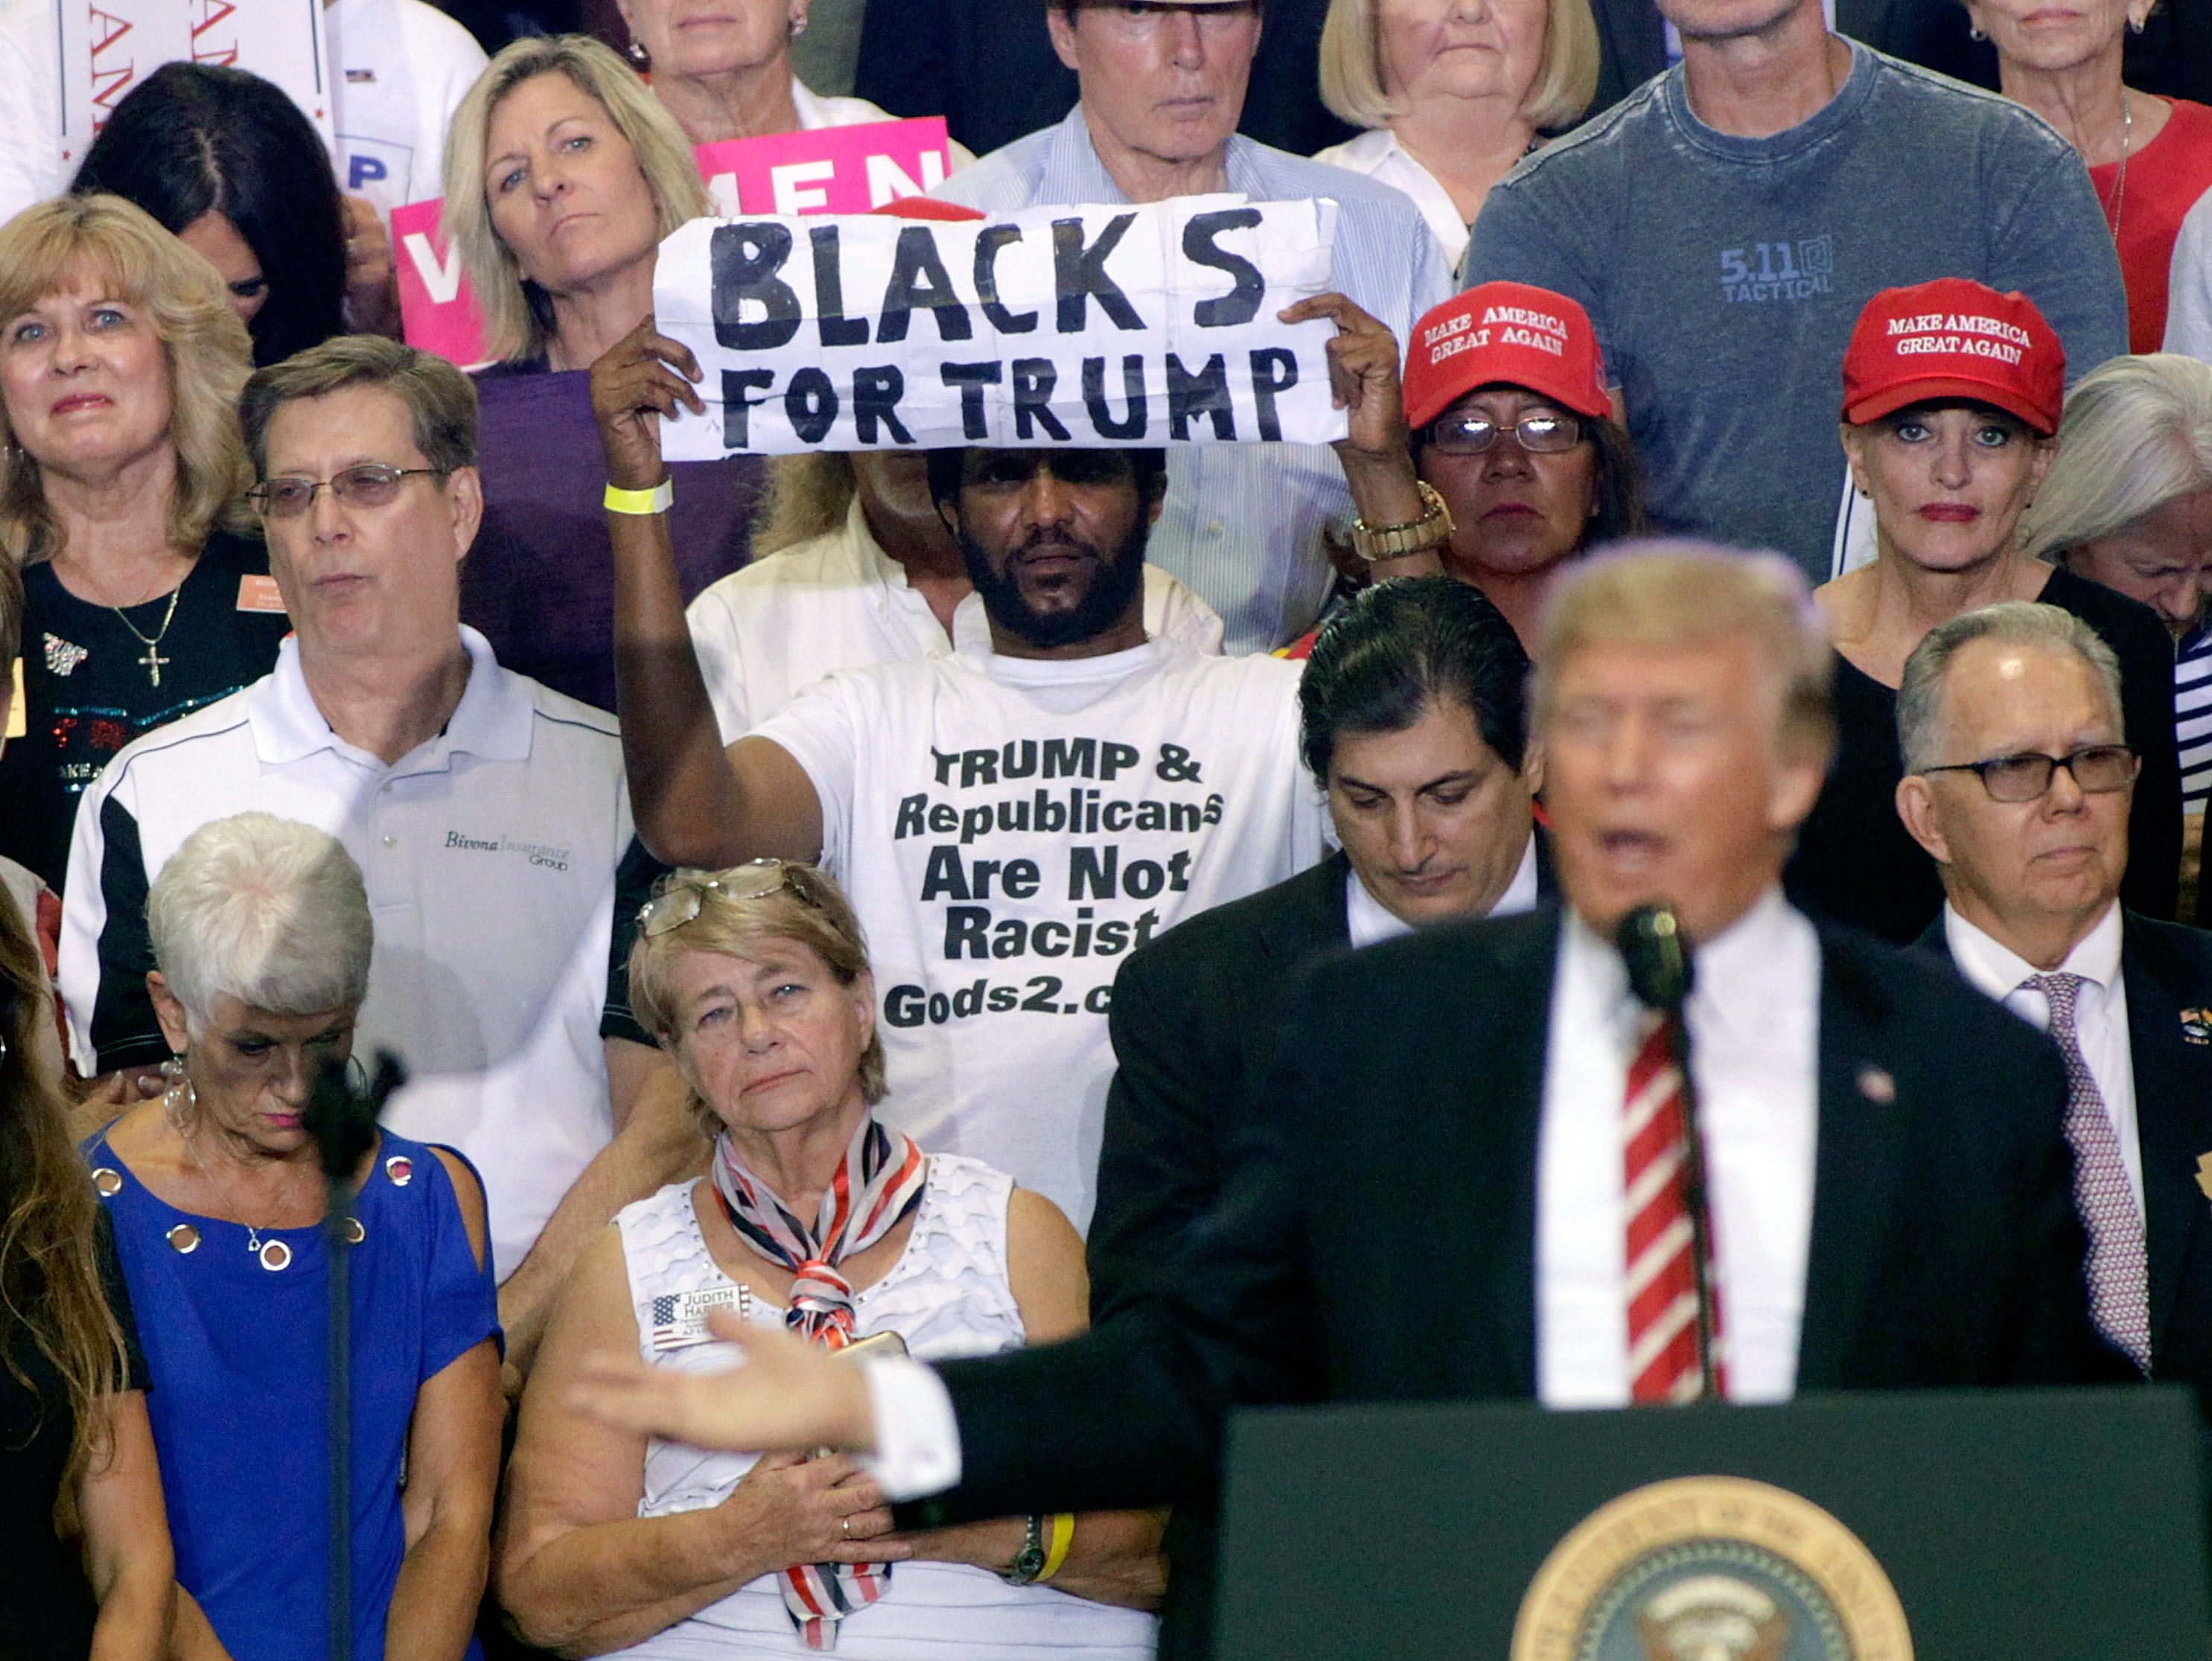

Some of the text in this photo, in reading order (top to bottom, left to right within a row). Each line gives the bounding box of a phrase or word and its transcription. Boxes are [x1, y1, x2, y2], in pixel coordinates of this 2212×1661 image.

[1721, 242, 1800, 284] 5.11
[1722, 275, 1834, 303] TACTICAL
[1424, 305, 1569, 348] MAKE AMERICA
[1430, 326, 1563, 365] GREAT AGAIN
[1886, 313, 2033, 348] MAKE AMERICA
[1896, 336, 2023, 366] GREAT AGAIN
[720, 346, 1298, 450] FOR TRUMP
[930, 737, 1204, 789] TRUMP &
[893, 788, 1225, 844] Republicans
[529, 854, 569, 873] Group
[919, 844, 1193, 902] Are Not
[943, 905, 1161, 960] Racist
[686, 1289, 734, 1307] JUDITH
